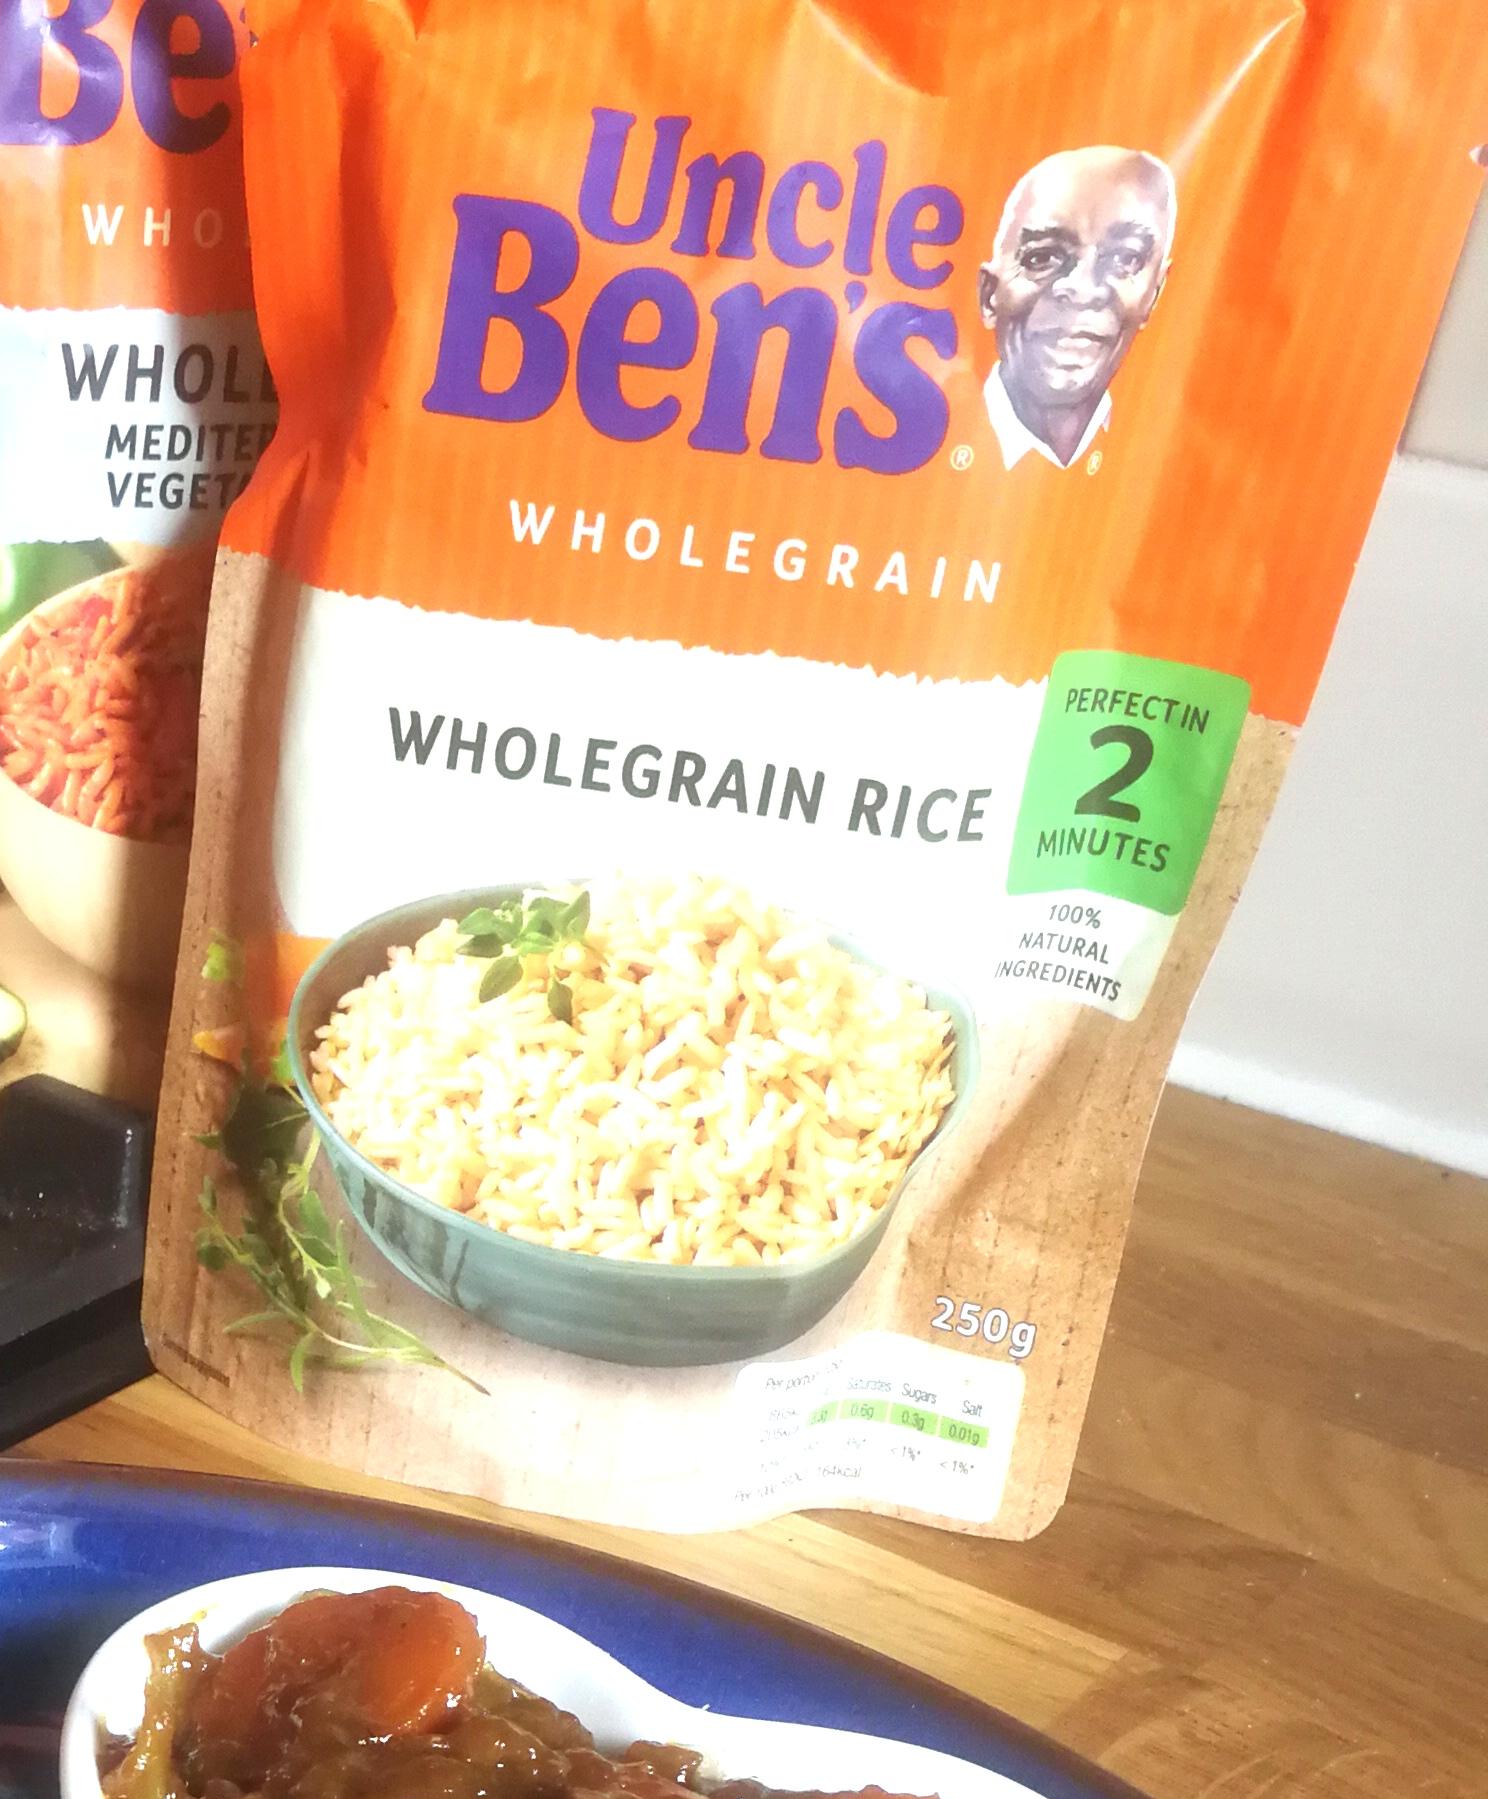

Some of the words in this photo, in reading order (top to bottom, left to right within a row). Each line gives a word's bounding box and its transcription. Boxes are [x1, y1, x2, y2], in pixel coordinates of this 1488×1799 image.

[576, 106, 965, 291] Uncle
[422, 193, 958, 475] Ben's
[107, 471, 252, 510] VEGET
[510, 500, 1001, 603] WHOLEGRAIN
[1065, 688, 1180, 723] PERFECT
[1181, 704, 1210, 734] IN
[389, 707, 825, 823] WHOLEGRAIN
[847, 778, 992, 842] RICE
[1074, 724, 1154, 823] 2
[1036, 827, 1171, 872] MINUTES
[1049, 904, 1101, 928] 100%
[1018, 932, 1109, 964] NATURAL
[994, 960, 1121, 1001] INGREDIENTS
[931, 1297, 1037, 1358] 250g
[902, 1383, 937, 1404] Sugars
[962, 1400, 983, 1417] Salt
[948, 1424, 980, 1446] 0.01g
